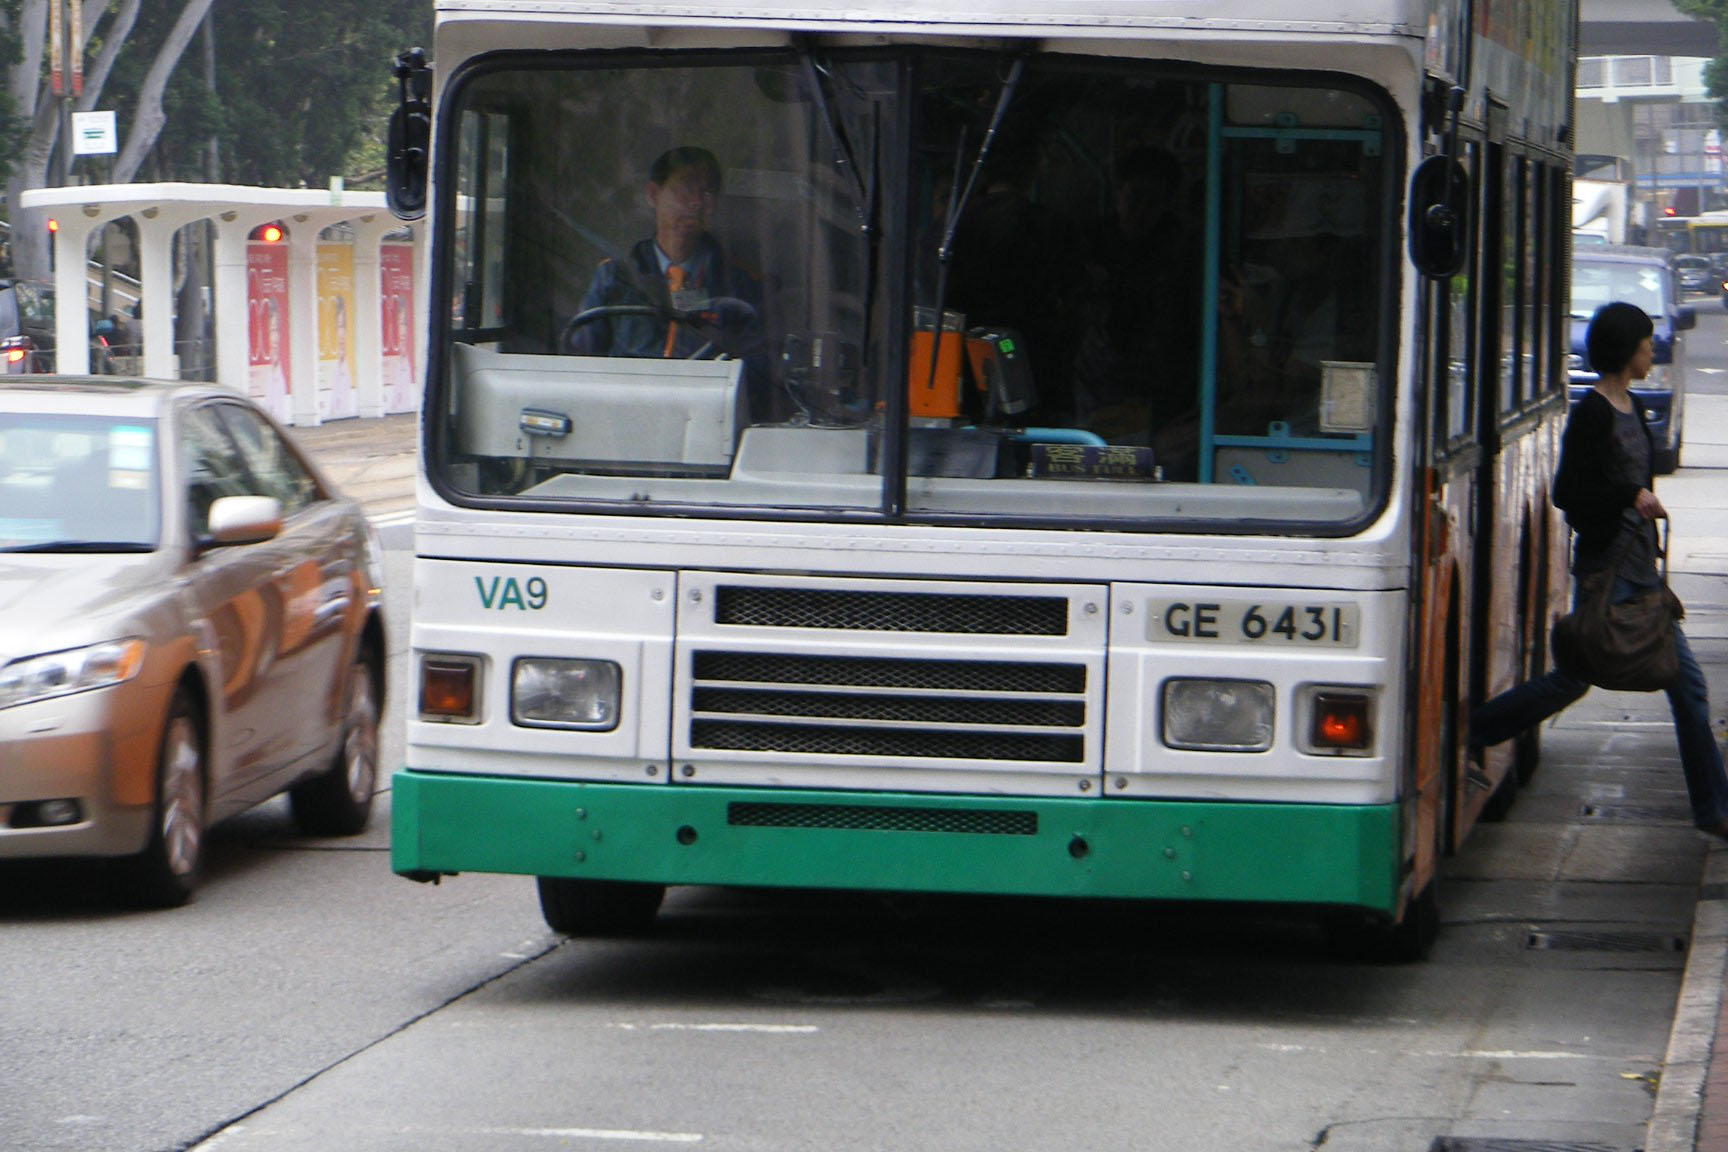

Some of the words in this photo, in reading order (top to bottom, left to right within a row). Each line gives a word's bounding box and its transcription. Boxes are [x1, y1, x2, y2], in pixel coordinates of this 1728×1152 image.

[474, 576, 548, 610] VA9
[1165, 603, 1221, 638] GE
[1242, 605, 1341, 641] 6431
